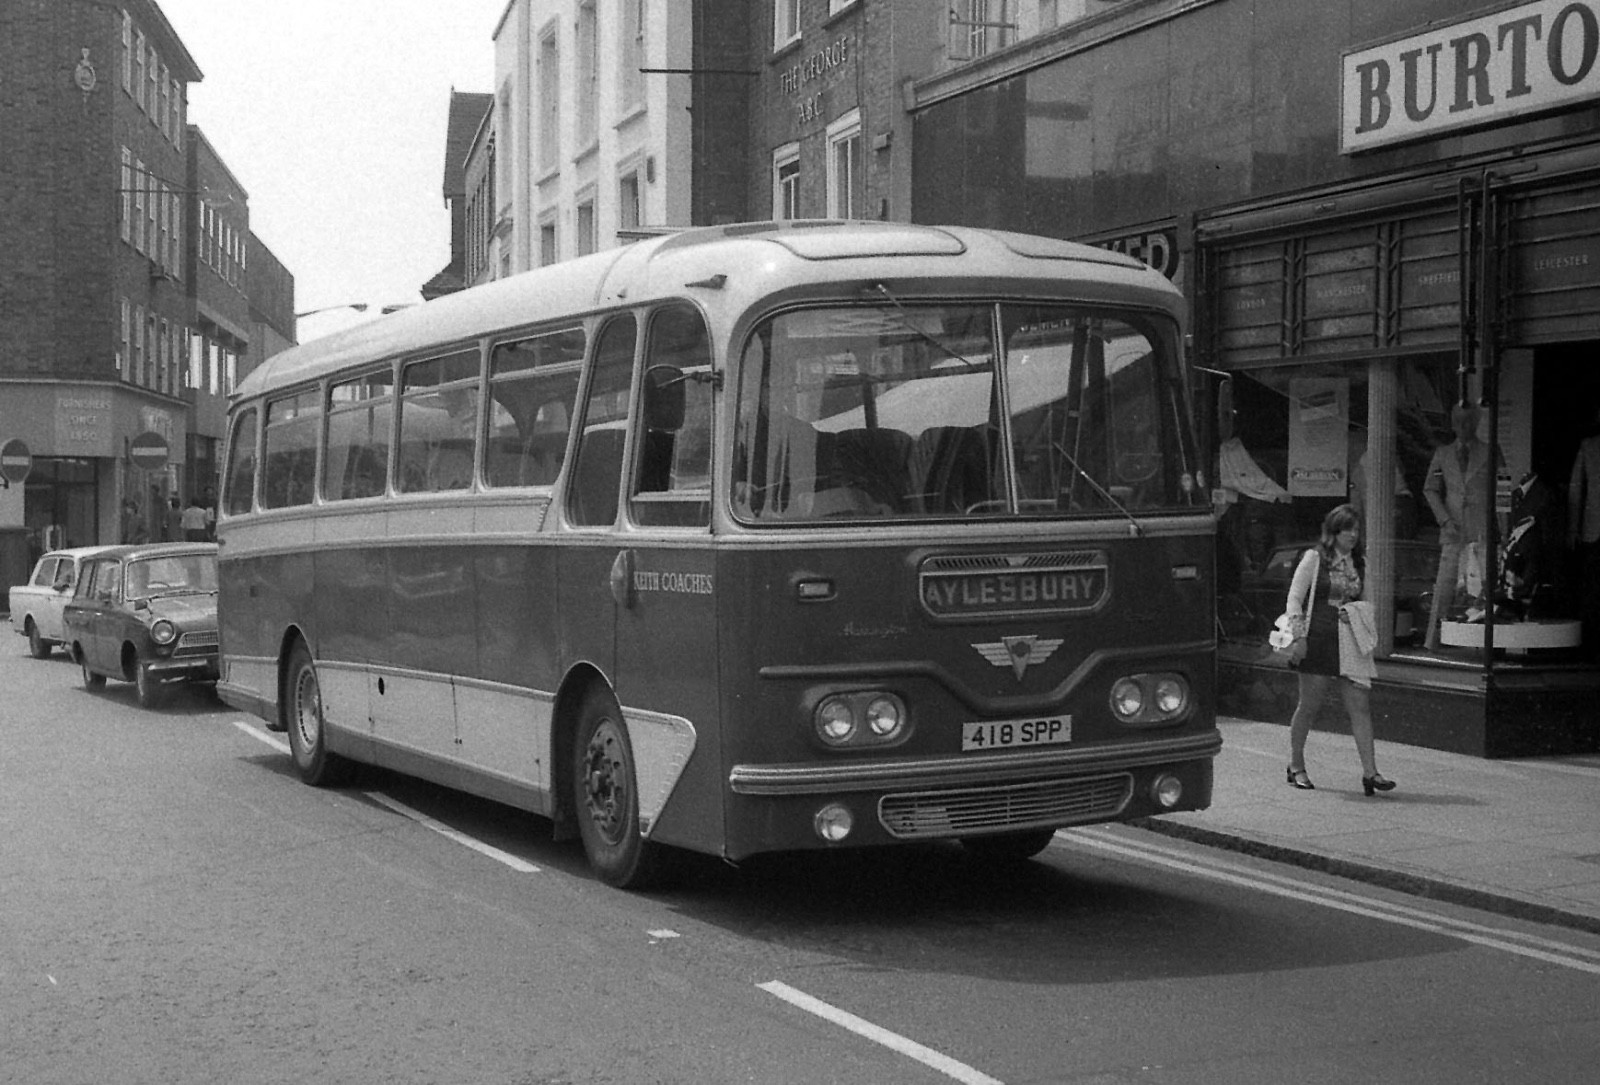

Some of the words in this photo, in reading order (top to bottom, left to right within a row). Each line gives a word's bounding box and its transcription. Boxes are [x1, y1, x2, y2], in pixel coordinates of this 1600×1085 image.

[780, 65, 799, 96] THE
[803, 35, 848, 83] GEORGE
[1355, 2, 1600, 134] BURTO
[633, 571, 659, 591] KEITH
[661, 572, 713, 595] COACHES
[926, 573, 1095, 607] AYLESBURY
[972, 723, 1013, 747] 418
[1021, 720, 1062, 743] SPP
